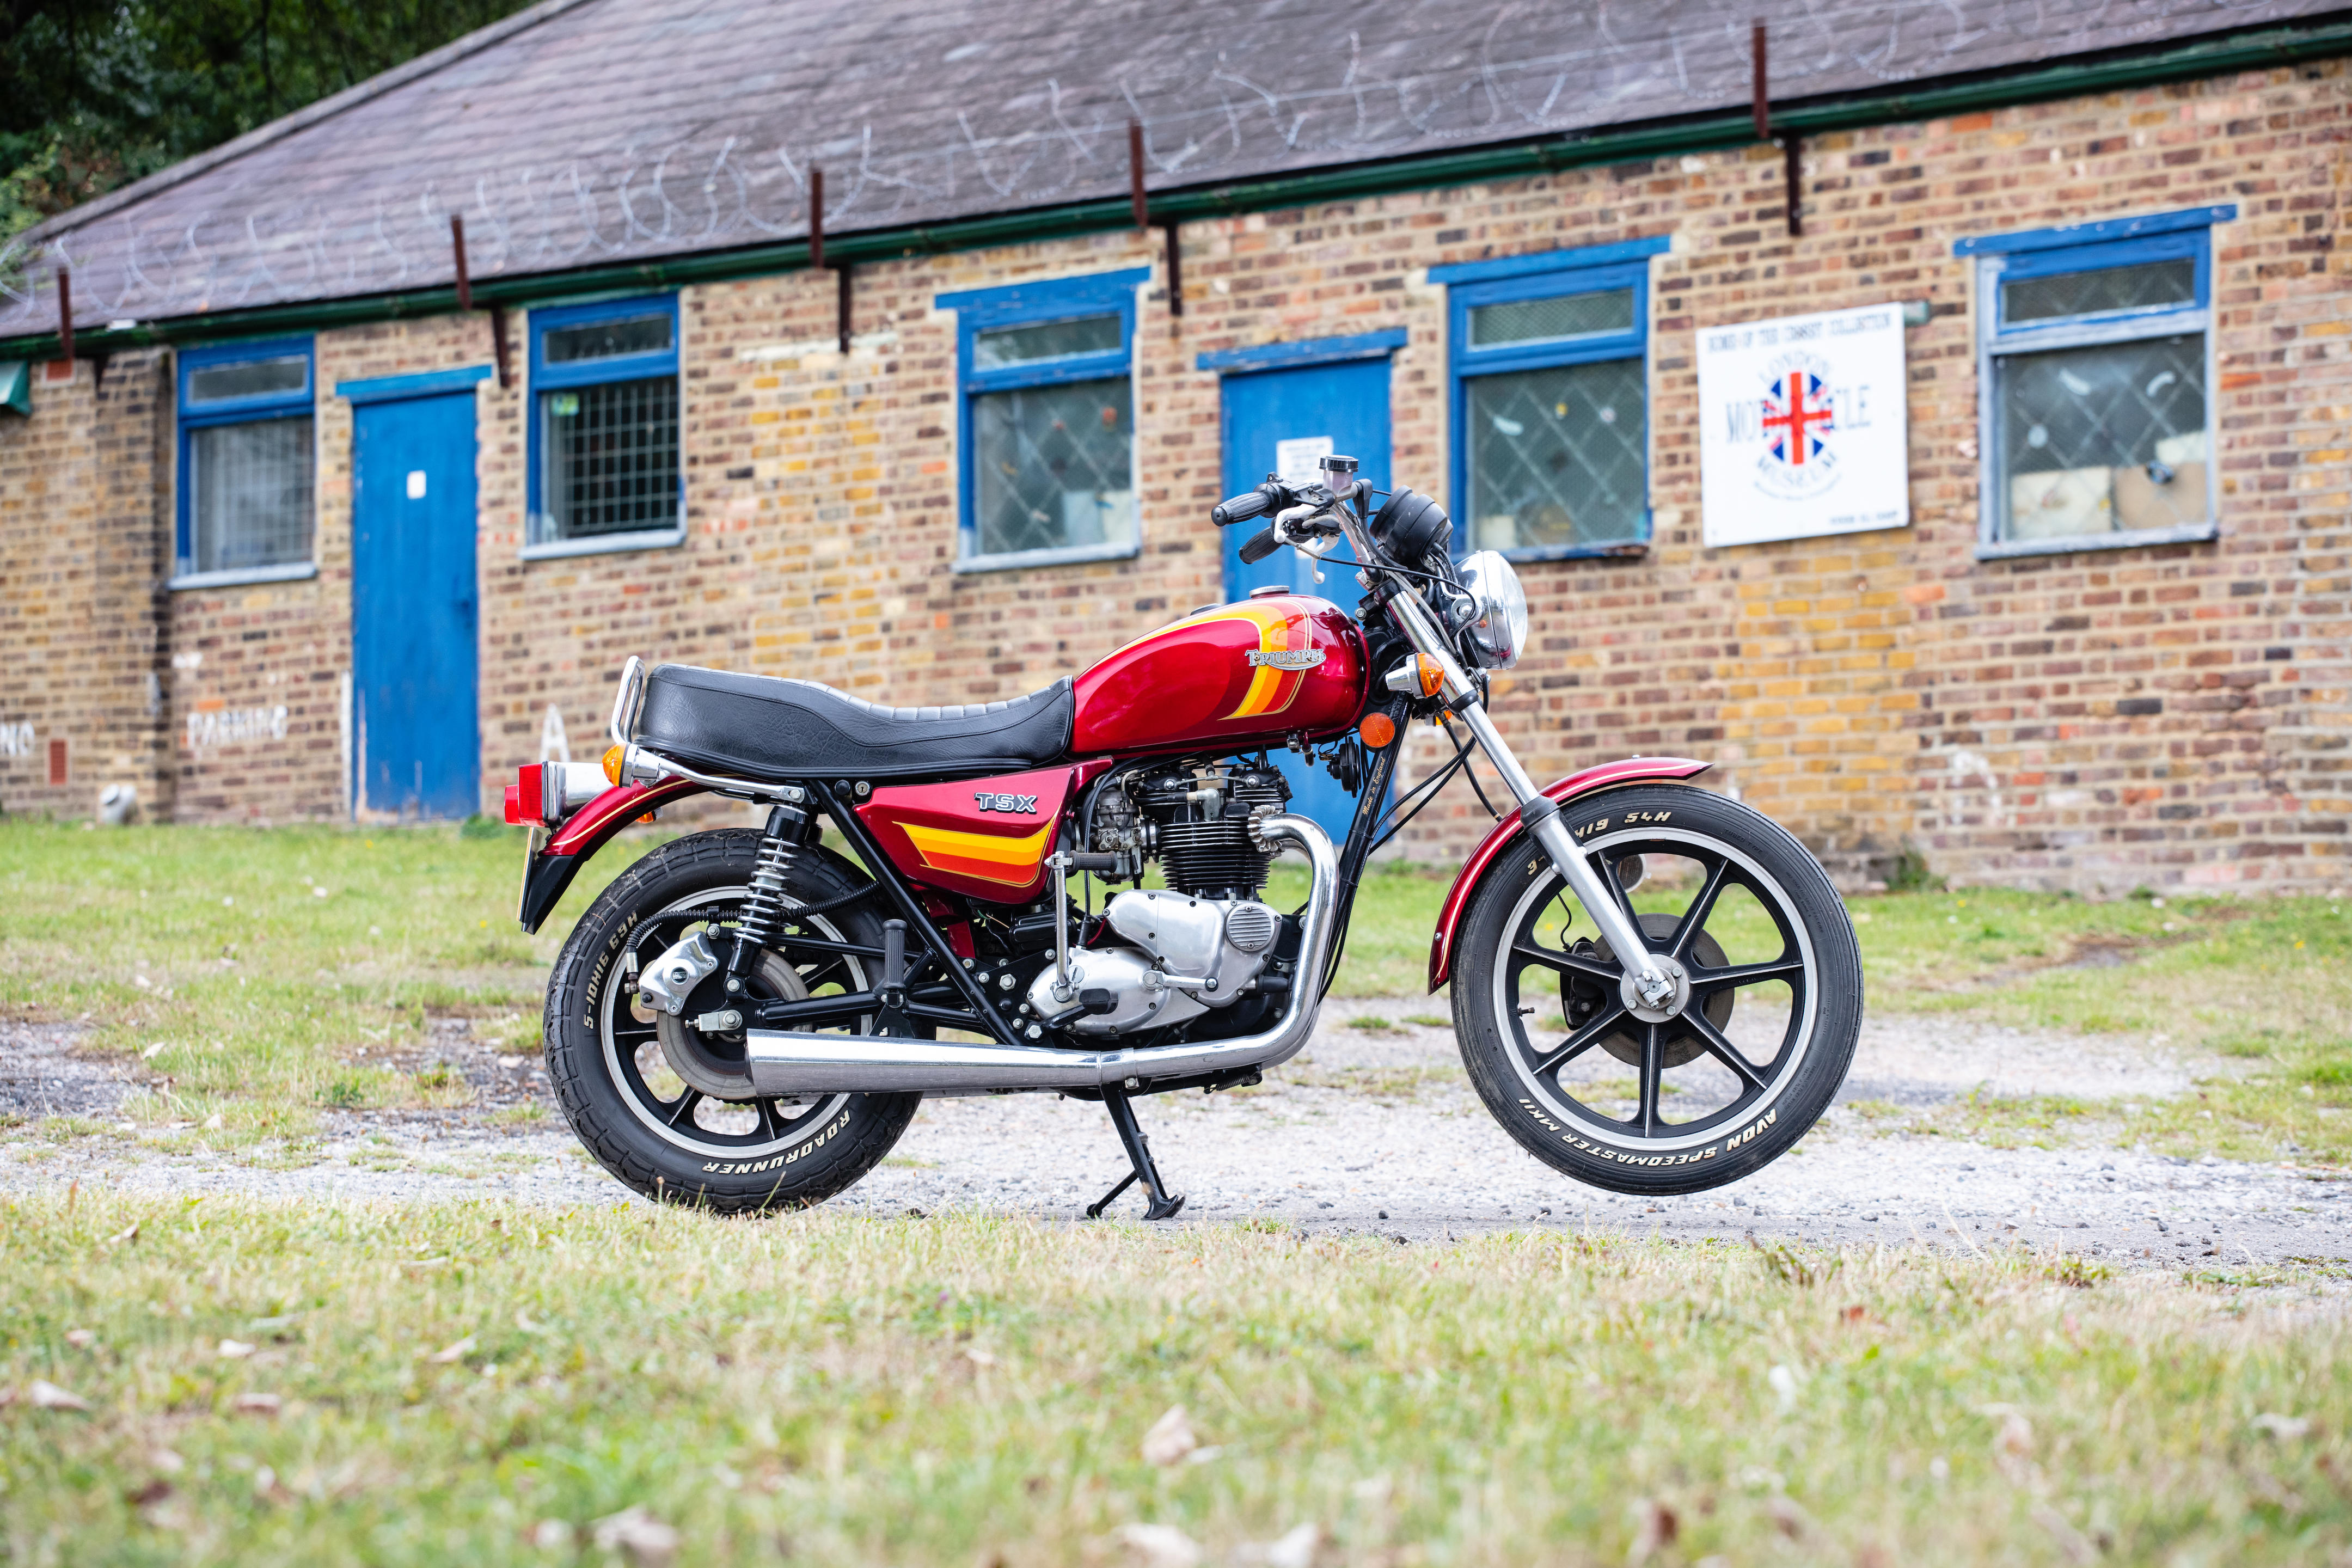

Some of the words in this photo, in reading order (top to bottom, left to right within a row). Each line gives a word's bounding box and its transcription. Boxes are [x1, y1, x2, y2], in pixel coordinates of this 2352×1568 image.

[1245, 648, 1325, 667] TRIUMPH
[187, 705, 287, 748] PARKING
[975, 793, 1038, 813] TSX
[702, 1110, 850, 1174] ROADRUNNER
[1726, 1108, 1777, 1152] AVON
[1561, 1133, 1718, 1166] SPEEDMASTER
